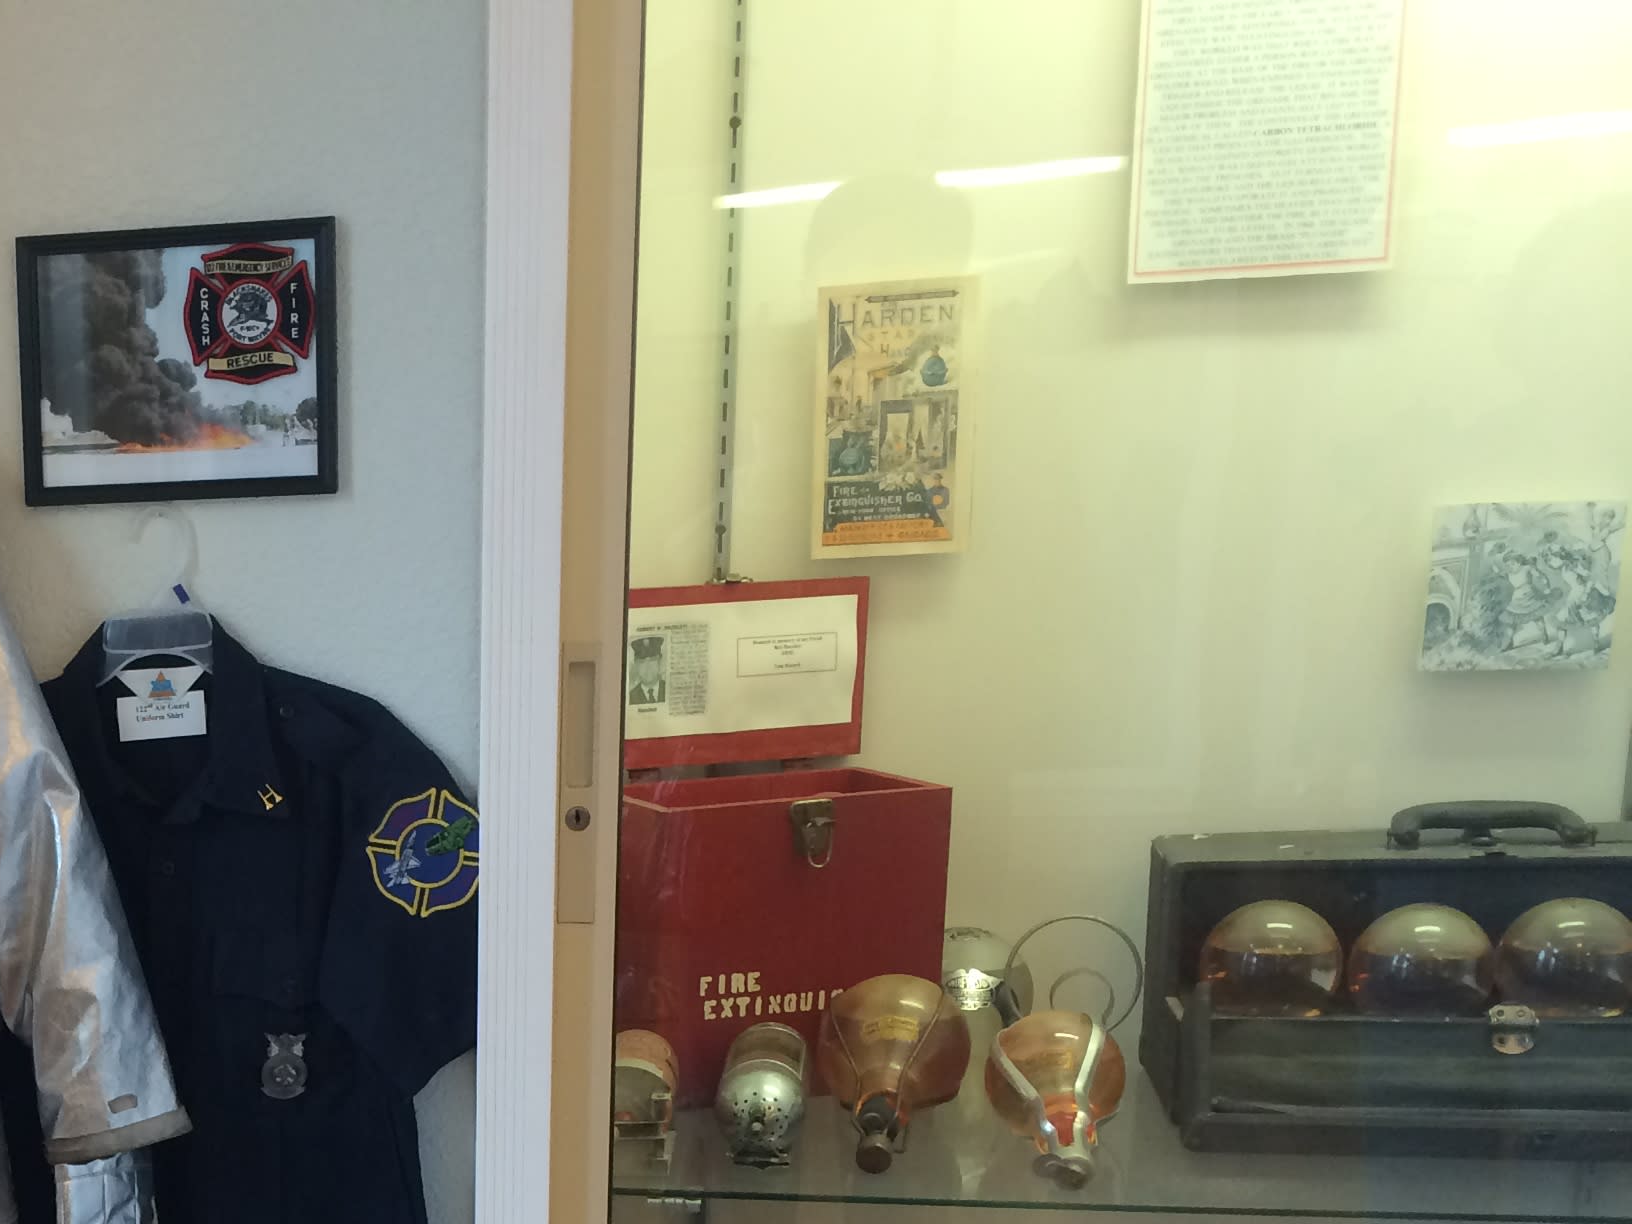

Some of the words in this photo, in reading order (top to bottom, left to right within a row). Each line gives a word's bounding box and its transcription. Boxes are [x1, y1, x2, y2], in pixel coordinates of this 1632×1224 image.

[199, 288, 211, 347] CRASH
[290, 282, 300, 340] FIRE
[836, 302, 954, 338] HARDEN
[226, 352, 275, 369] RESCUE
[833, 486, 858, 499] FIRE
[699, 971, 761, 997] FIRE
